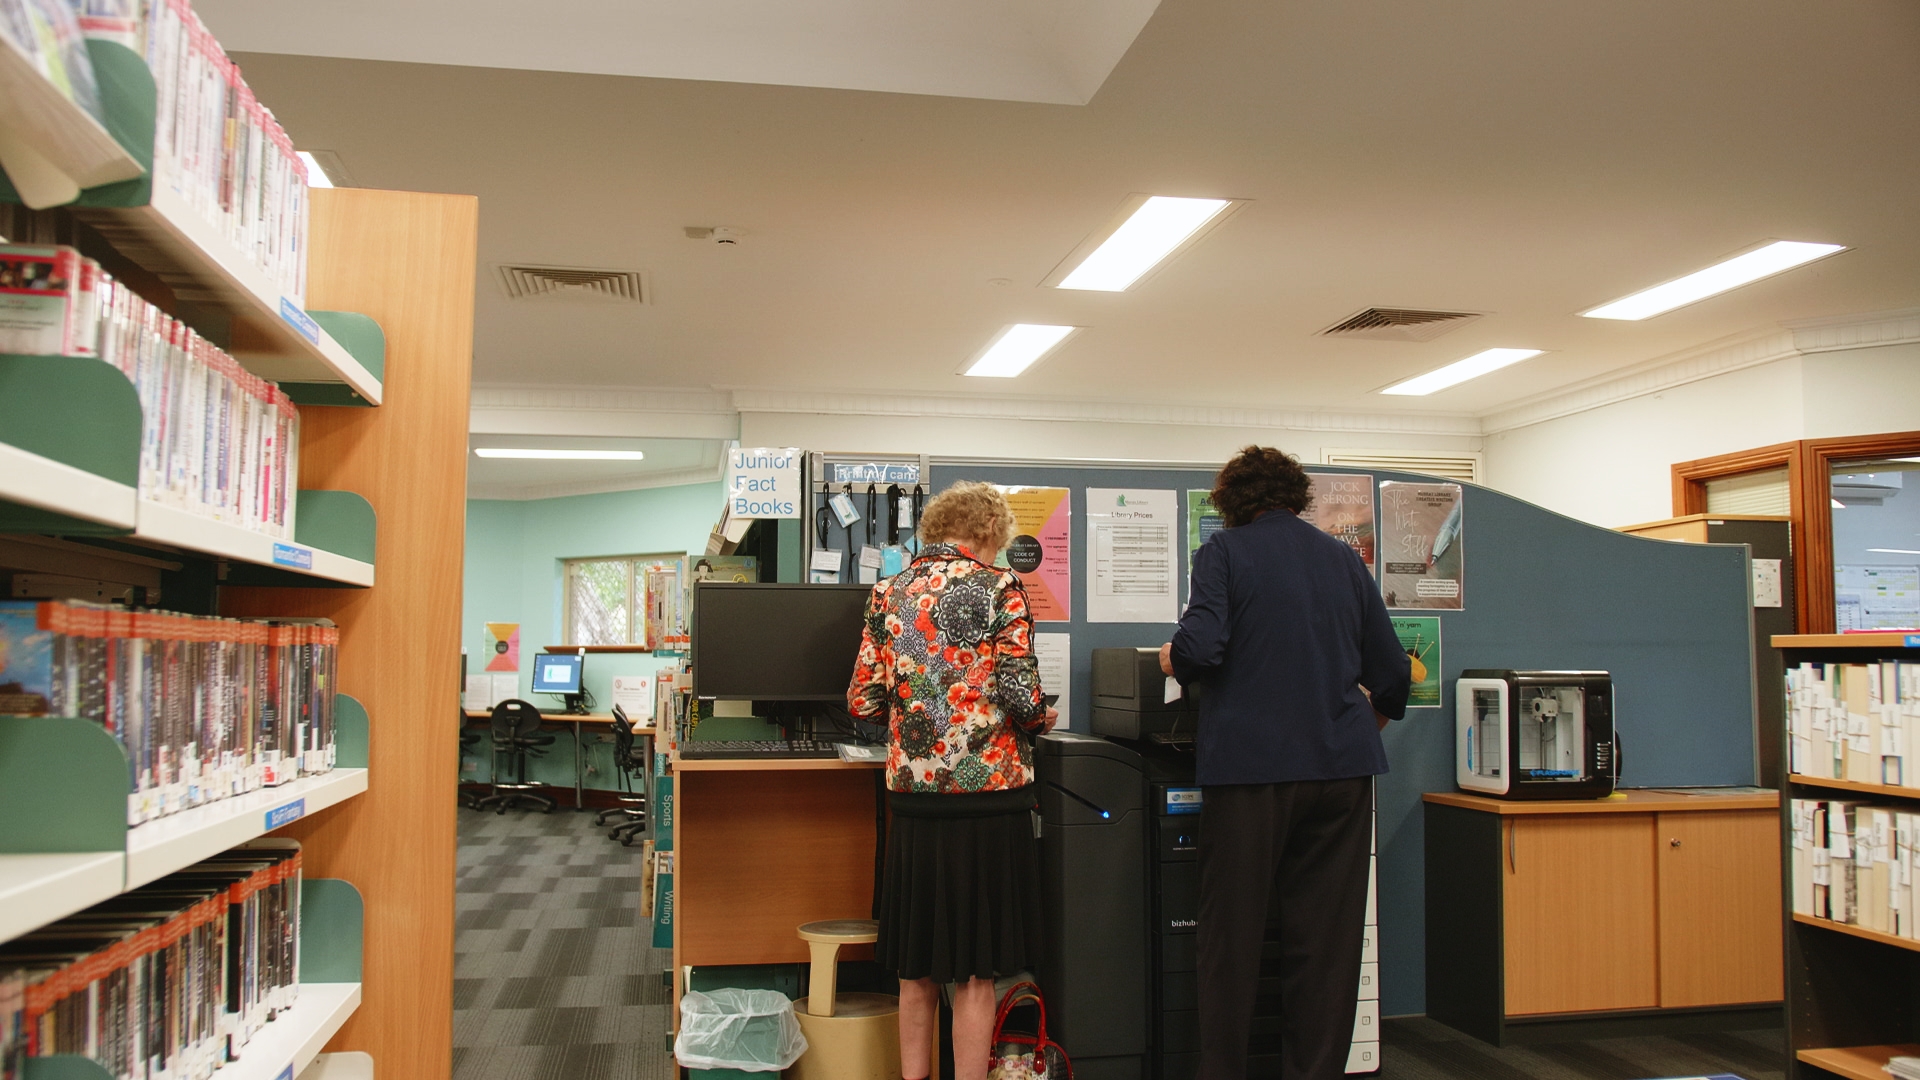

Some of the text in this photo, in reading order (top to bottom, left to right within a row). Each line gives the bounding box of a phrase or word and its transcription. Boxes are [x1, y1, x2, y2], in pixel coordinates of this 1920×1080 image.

[735, 453, 792, 469] Junior
[736, 475, 776, 492] Fact
[1329, 481, 1361, 494] JOCK
[1322, 494, 1369, 505] SERONG
[736, 498, 794, 515] Books
[1111, 511, 1153, 520] Library Prices
[1337, 512, 1355, 522] ON
[1334, 524, 1359, 534] THE
[663, 794, 673, 827] Sports
[660, 890, 673, 925] Writing
[1171, 919, 1196, 927] bizhub
